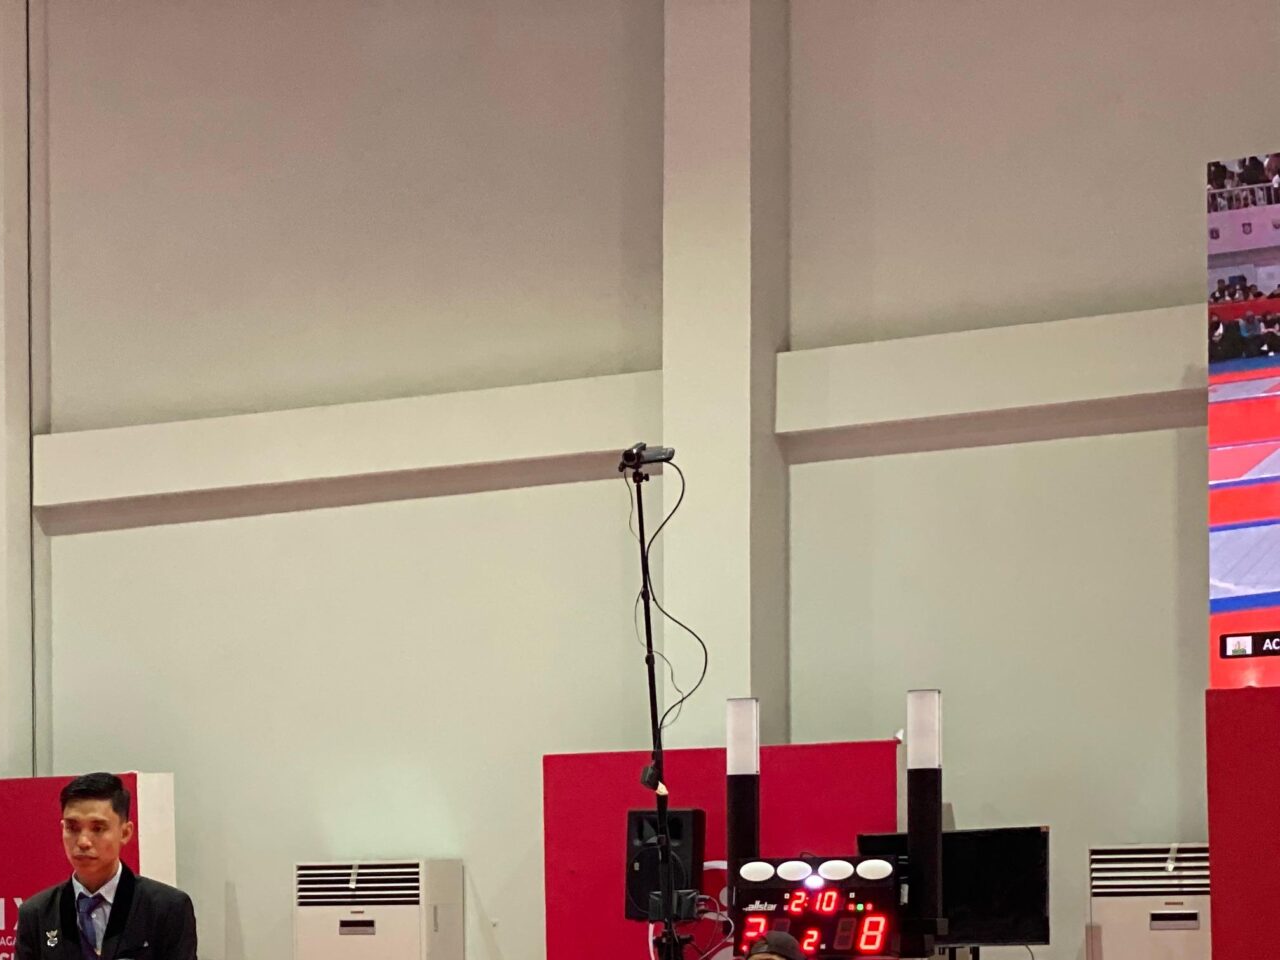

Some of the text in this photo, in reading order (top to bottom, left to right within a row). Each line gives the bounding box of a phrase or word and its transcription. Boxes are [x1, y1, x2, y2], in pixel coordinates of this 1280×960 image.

[743, 900, 778, 912] allstar
[790, 891, 837, 912] 2:10
[803, 930, 818, 950] 2
[859, 916, 886, 950] 8
